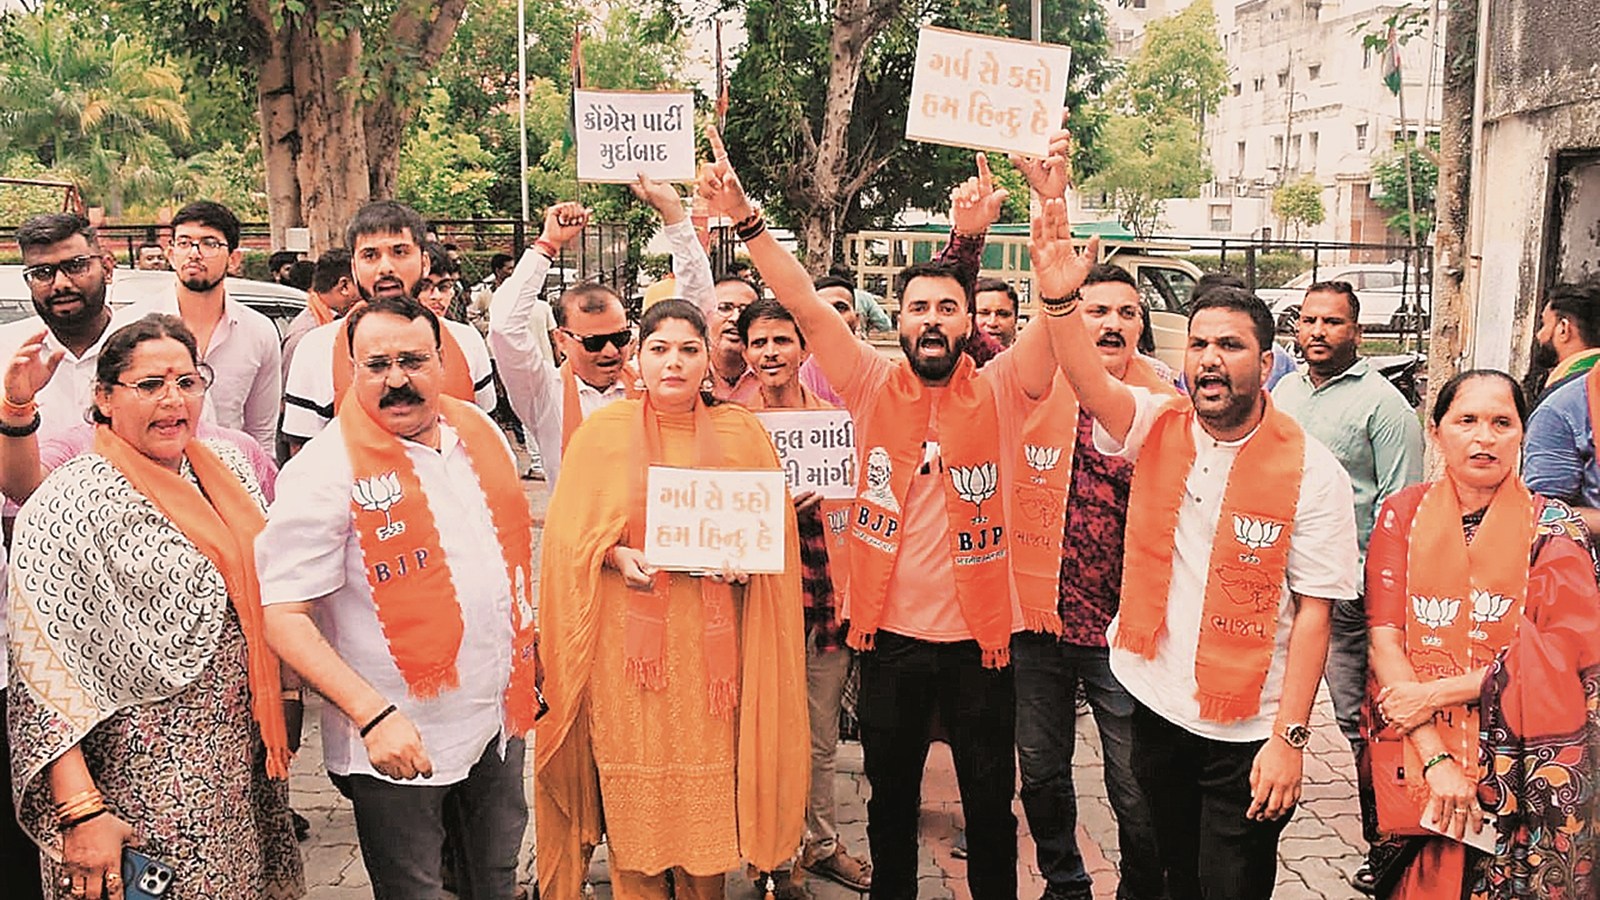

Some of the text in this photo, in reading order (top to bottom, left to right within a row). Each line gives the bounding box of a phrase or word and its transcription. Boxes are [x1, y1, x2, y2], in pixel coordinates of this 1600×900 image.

[1008, 58, 1052, 93] કહો
[643, 104, 684, 132] પાર્ટી
[600, 136, 668, 169] મુર્દાબાદ
[810, 420, 856, 448] ગાંધી
